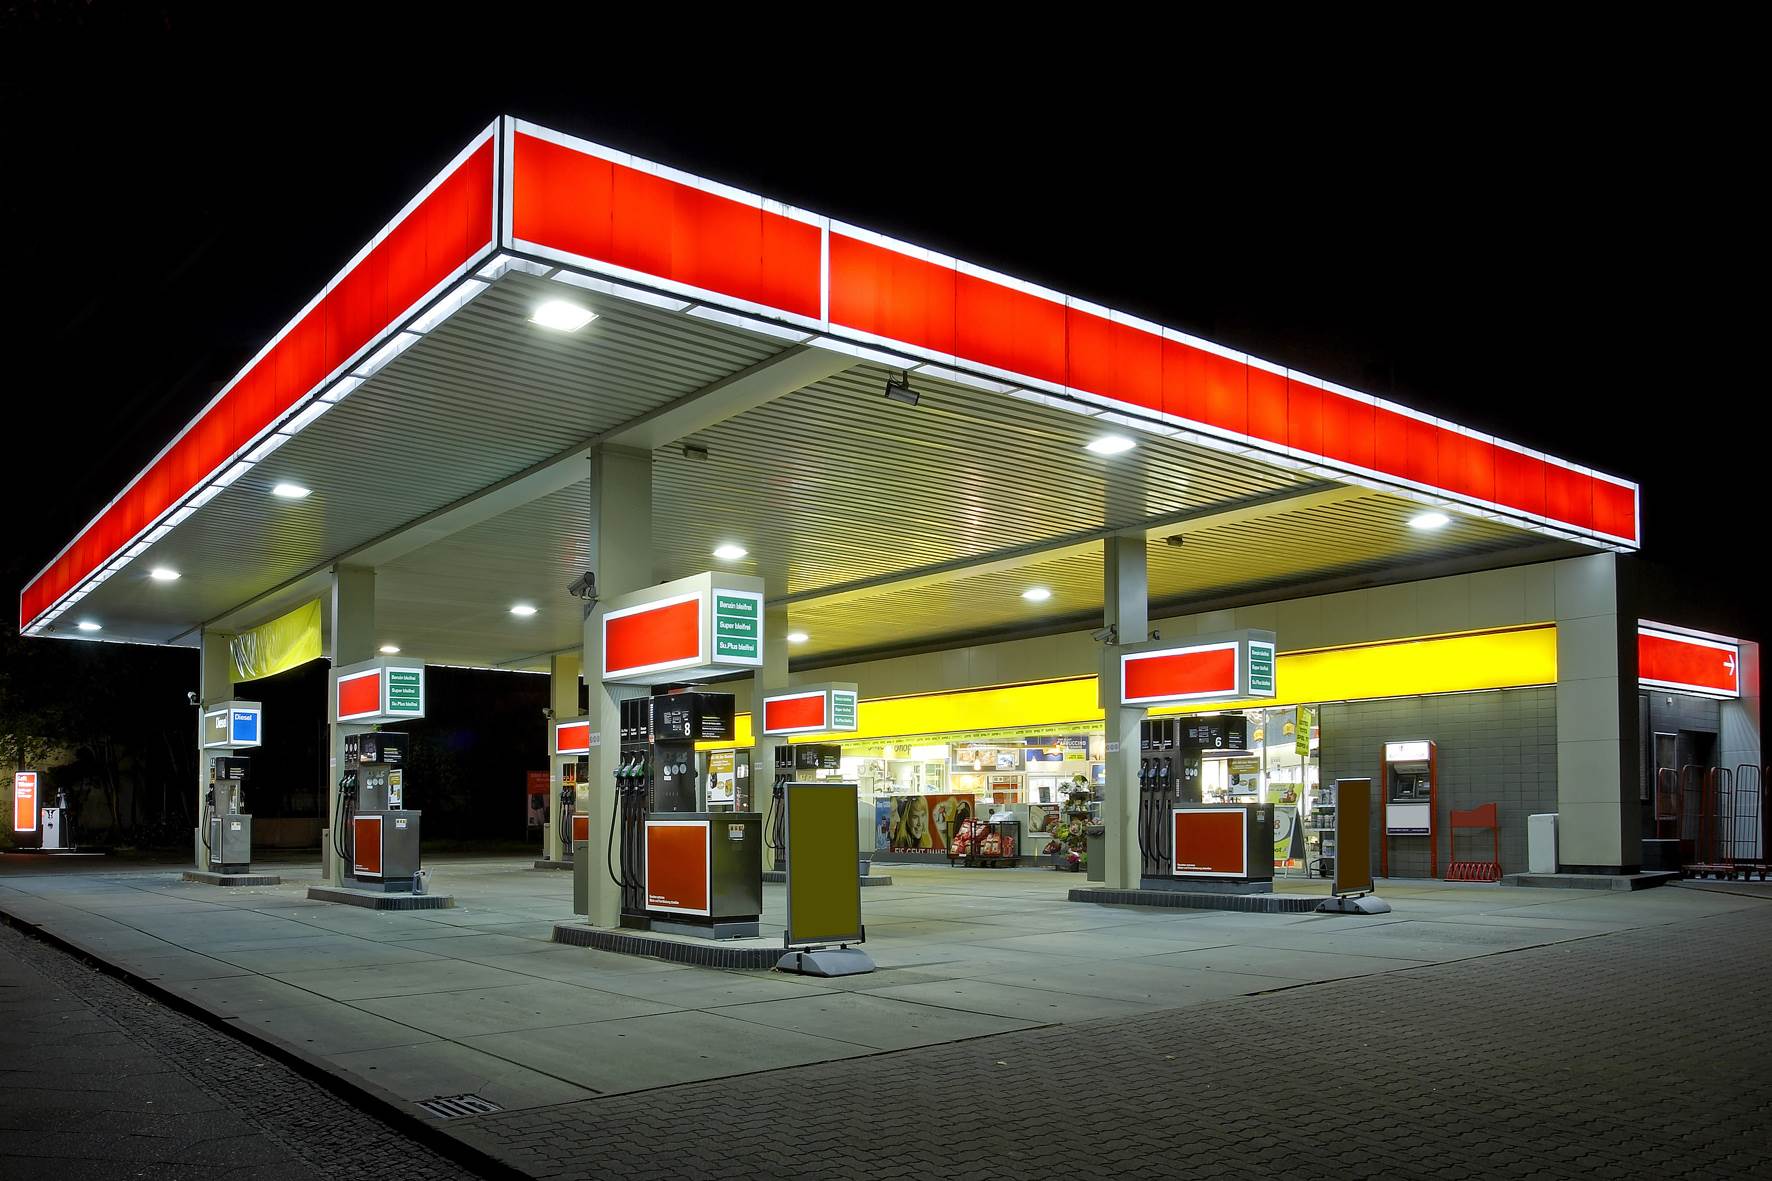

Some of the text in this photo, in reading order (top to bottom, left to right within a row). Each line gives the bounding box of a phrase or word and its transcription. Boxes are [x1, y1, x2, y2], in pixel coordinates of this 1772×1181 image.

[720, 601, 752, 611] Benzin bleifrei
[720, 621, 734, 630] Super
[720, 642, 737, 650] Su.Plus
[684, 722, 691, 736] 8
[1215, 737, 1222, 747] 6
[814, 759, 819, 767] 4
